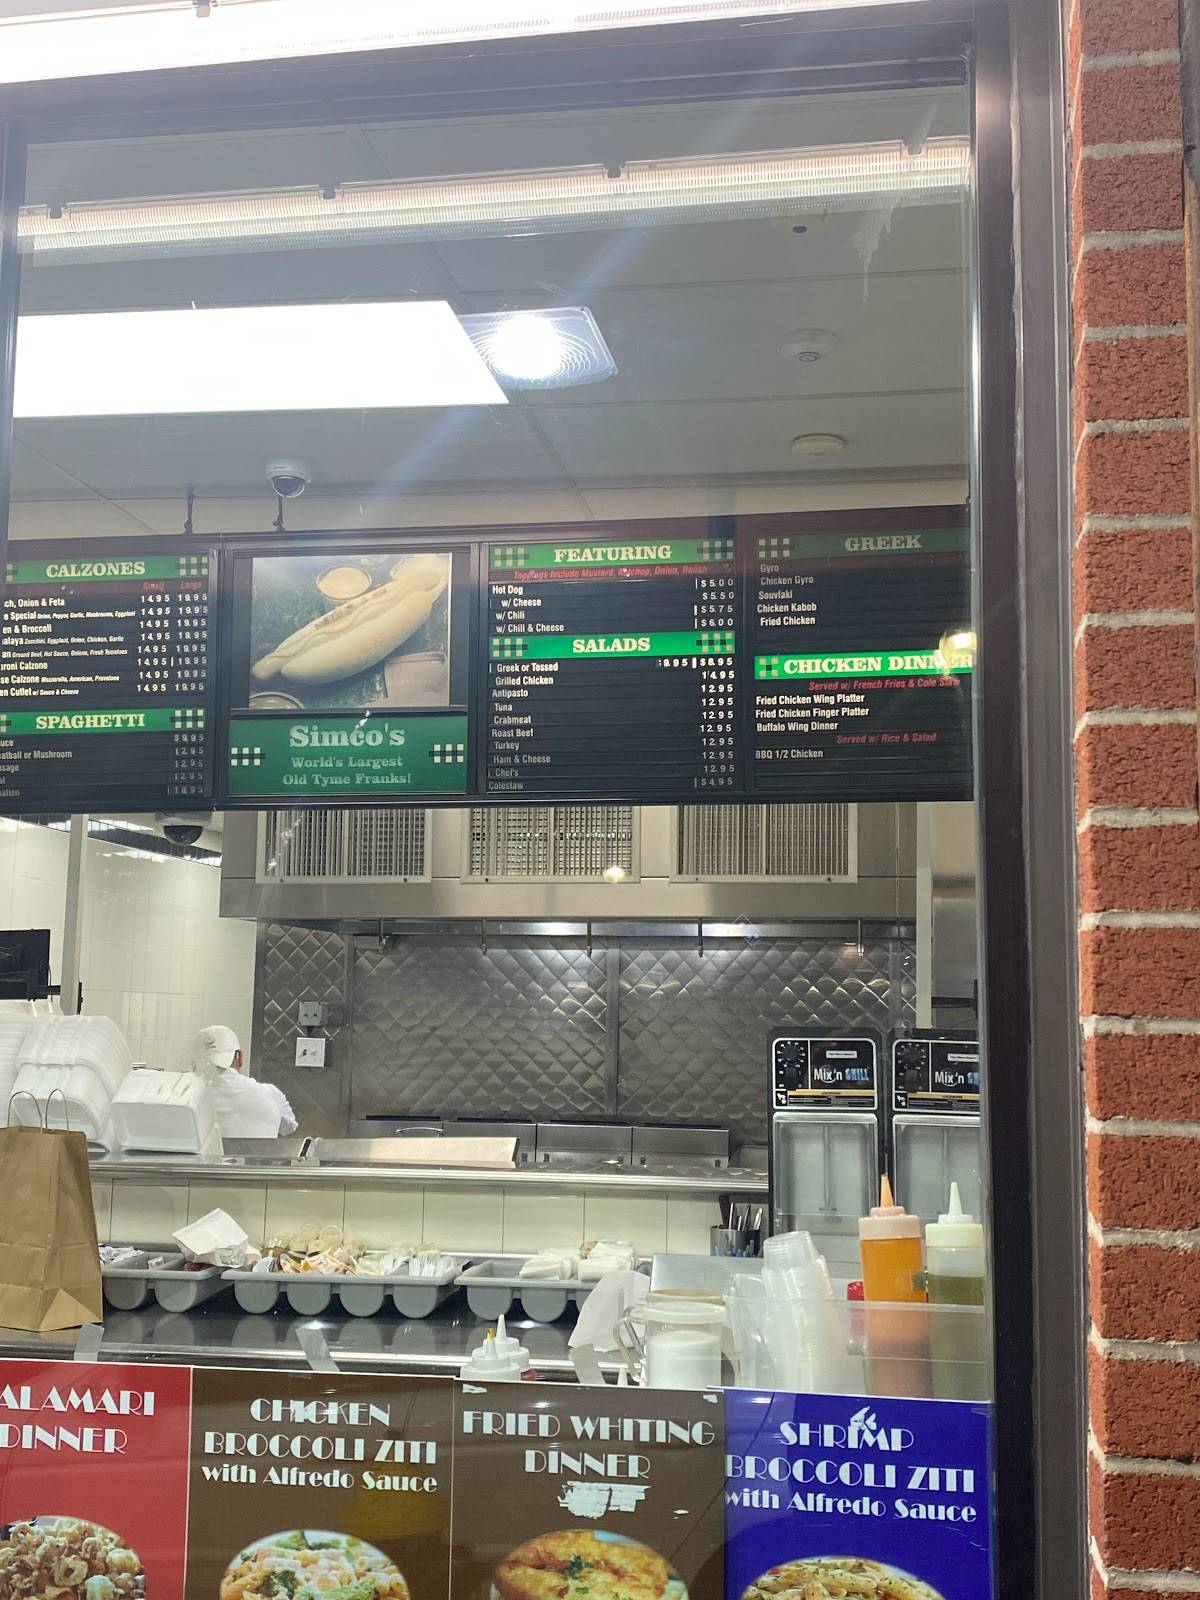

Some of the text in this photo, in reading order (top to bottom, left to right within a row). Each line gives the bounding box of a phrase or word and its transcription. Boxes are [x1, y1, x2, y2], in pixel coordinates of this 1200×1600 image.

[845, 534, 923, 552] GREEK
[554, 545, 672, 562] FEATURING
[46, 562, 146, 578] CALZONES
[550, 569, 580, 578] Include
[760, 564, 779, 573] Gyro
[760, 576, 814, 586] Chicken Gyro
[492, 585, 506, 595] Hot
[508, 585, 523, 595] Dog
[759, 590, 792, 600] Souvlaki
[18, 599, 39, 607] Onion
[49, 598, 65, 606] Feta
[501, 599, 511, 608] w/
[513, 598, 541, 607] Cheese
[757, 602, 817, 613] Chicken Kabob
[11, 612, 36, 620] Special
[496, 612, 505, 621] w/
[508, 611, 525, 620] Chili
[760, 616, 815, 627] Fried Chicken
[14, 625, 20, 634] &
[22, 624, 52, 632] Broccoli
[496, 625, 506, 634] w/
[508, 624, 525, 633] Chili
[528, 624, 534, 632] &
[536, 624, 564, 632] Cheese
[572, 638, 650, 653] SALADS
[20, 662, 48, 670] Calzone
[497, 663, 519, 672] Greek
[531, 662, 558, 671] Tossed
[783, 657, 882, 674] CHICKEN
[11, 675, 39, 683] Calzone
[496, 677, 520, 685] Grilled
[523, 676, 554, 685] Chicken
[809, 682, 838, 691] Served
[840, 682, 850, 690] w/
[854, 681, 883, 689] French
[885, 680, 905, 688] Fries
[917, 678, 936, 687] Cole
[10, 688, 32, 696] Cutlet
[492, 684, 733, 699] Antipasto 12.95
[494, 698, 733, 711] Tuna 12.95
[756, 694, 865, 705] Fried Chicken Wing Platter
[494, 711, 733, 724] Crabmeat 12.95
[756, 707, 870, 719] Fried Chicken Finger Platter
[36, 714, 145, 729] SPAGHETTI
[756, 722, 838, 732] Buffalo Wing Dinner
[289, 723, 405, 747] Simco's
[492, 729, 514, 737] Roast
[516, 728, 533, 737] Beef
[836, 733, 936, 744] Served w/ Rice & Salad
[494, 738, 734, 751] Turkey 12.95
[34, 750, 72, 758] Mushroom
[494, 756, 511, 764] Ham
[514, 755, 520, 763] &
[522, 755, 551, 763] Cheese
[755, 749, 823, 759] BBQ 1/2 Chicken
[291, 756, 404, 768] World's Largest
[282, 772, 412, 786] Old Tyme Franks!
[250, 1398, 390, 1427] CHICKEN
[462, 1410, 715, 1447] FRIED WHITING
[0, 1424, 128, 1455] DINNER
[780, 1420, 914, 1452] SHRIMP
[204, 1432, 437, 1464] BROCCOLI ZITI
[524, 1449, 651, 1480] DINNER
[202, 1464, 438, 1492] with Alfredo Sauce
[725, 1454, 976, 1493] BROCCOLI ZITI
[725, 1488, 977, 1523] with Alfredo Sauce
